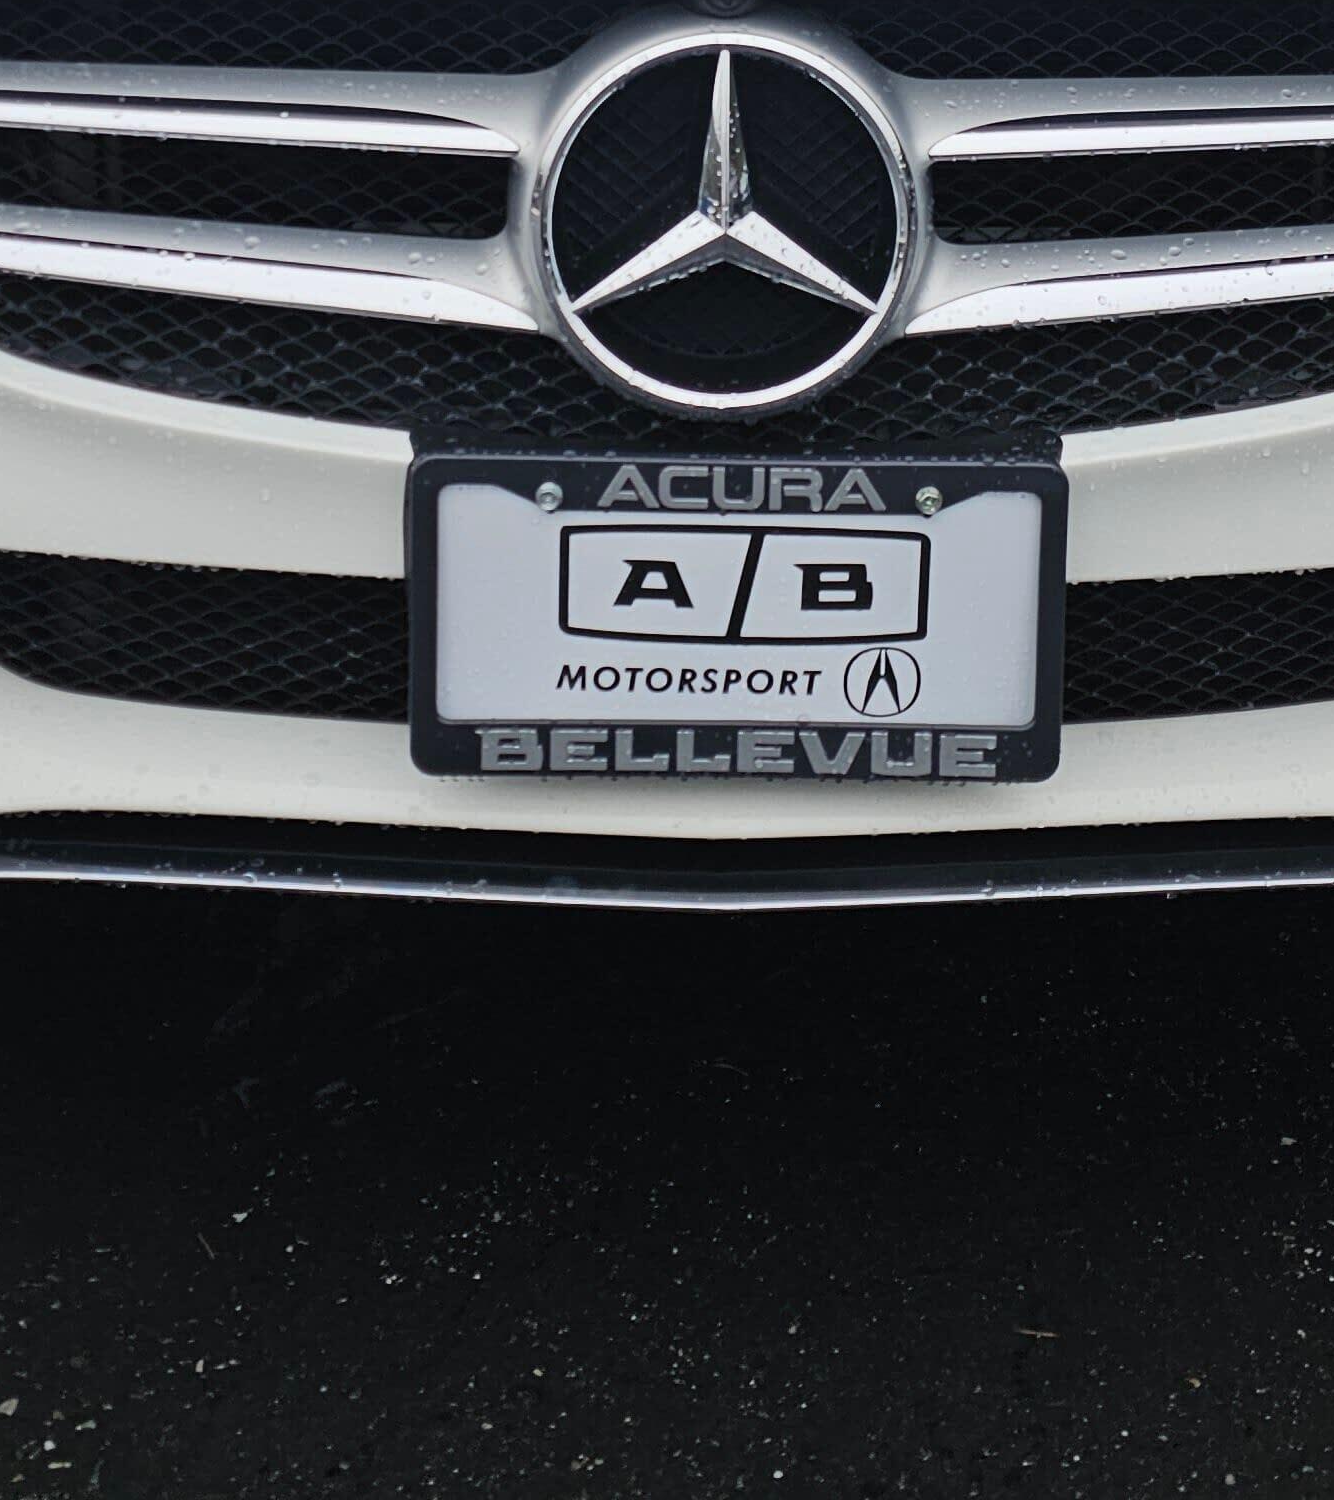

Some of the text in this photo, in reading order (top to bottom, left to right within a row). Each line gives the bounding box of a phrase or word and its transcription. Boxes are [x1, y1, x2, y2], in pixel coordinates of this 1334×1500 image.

[598, 463, 886, 512] ACURA
[613, 559, 873, 610] A B
[556, 663, 823, 696] MOTORSPORT
[475, 726, 998, 778] BELLEVUE
